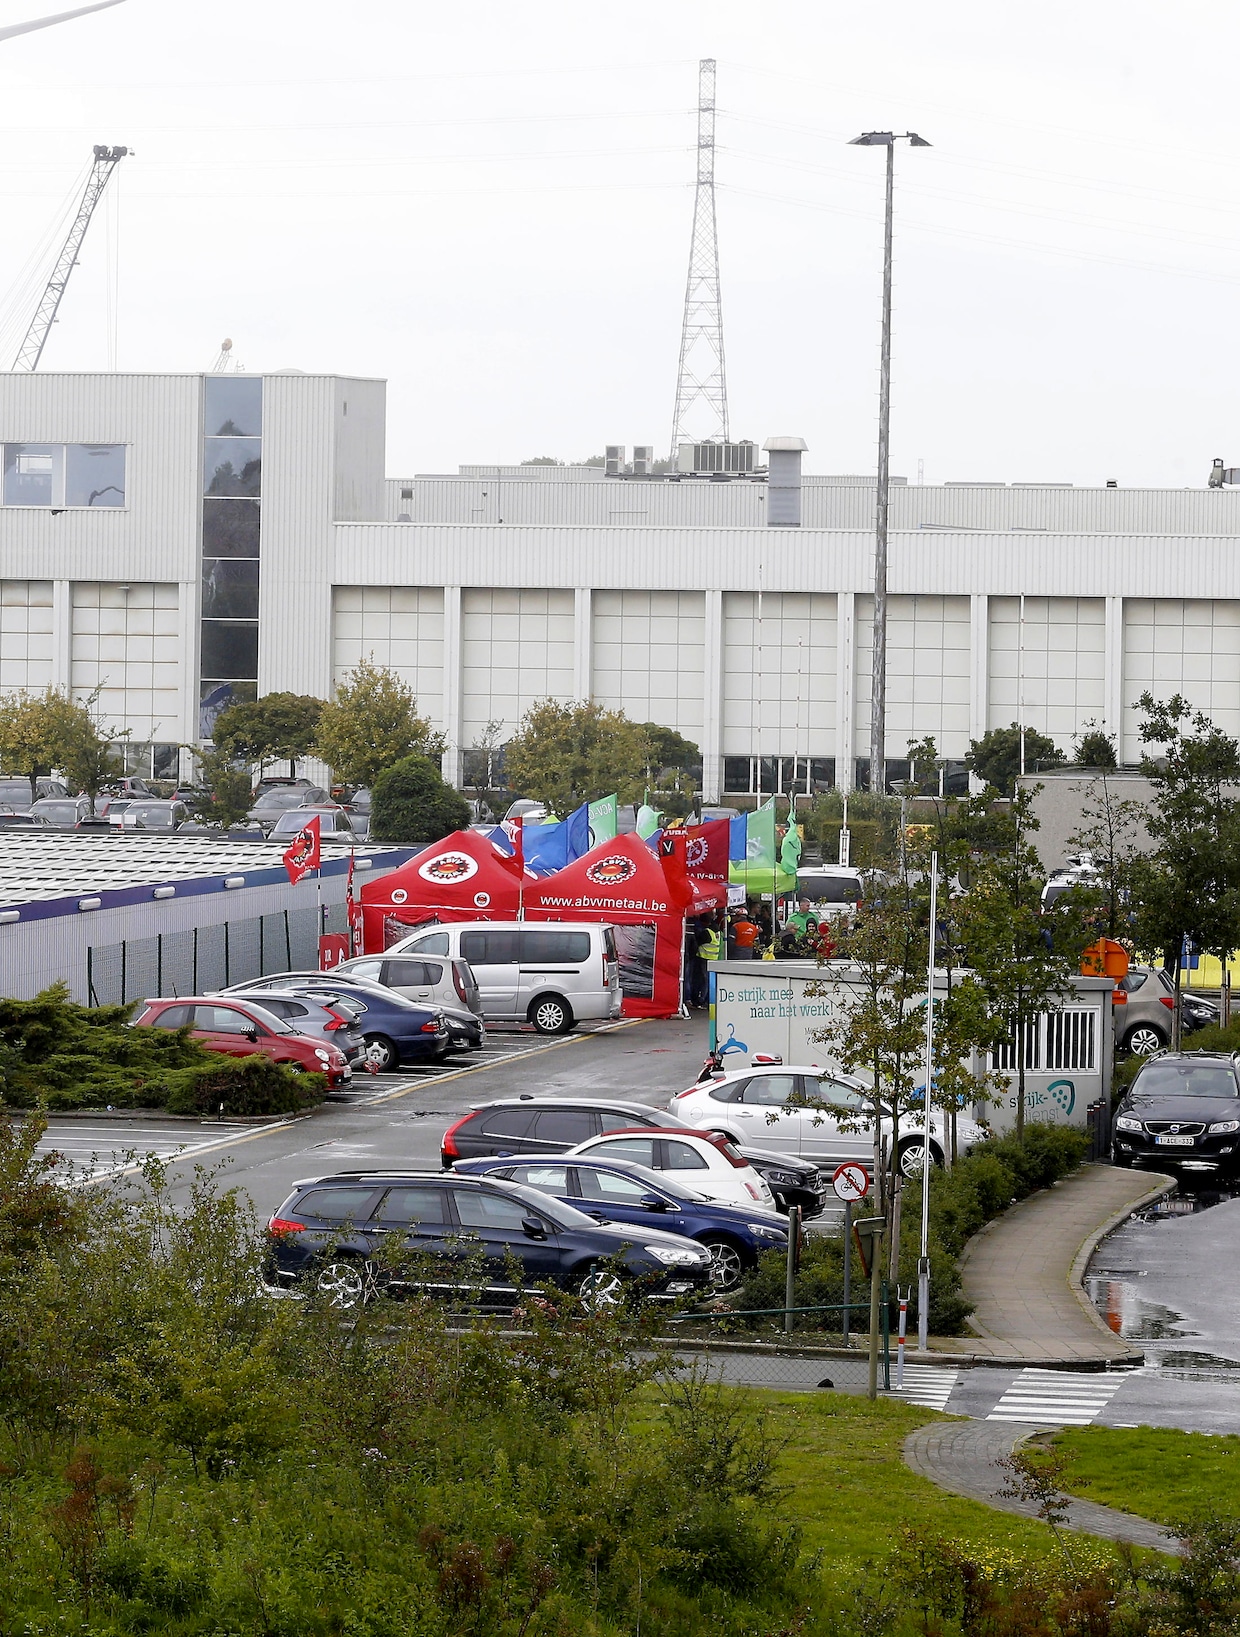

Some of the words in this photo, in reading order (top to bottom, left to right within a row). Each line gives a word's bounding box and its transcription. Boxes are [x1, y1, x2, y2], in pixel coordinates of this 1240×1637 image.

[602, 859, 627, 867] ABVV
[593, 871, 628, 881] METAAL
[540, 895, 667, 912] www.abvvmetaal.be
[719, 988, 735, 1003] De
[738, 986, 766, 1005] strijk
[769, 989, 794, 1001] mee
[750, 1006, 776, 1019] naar
[779, 1003, 797, 1018] het
[800, 1001, 834, 1017] werk!
[1009, 1091, 1048, 1108] sijk-
